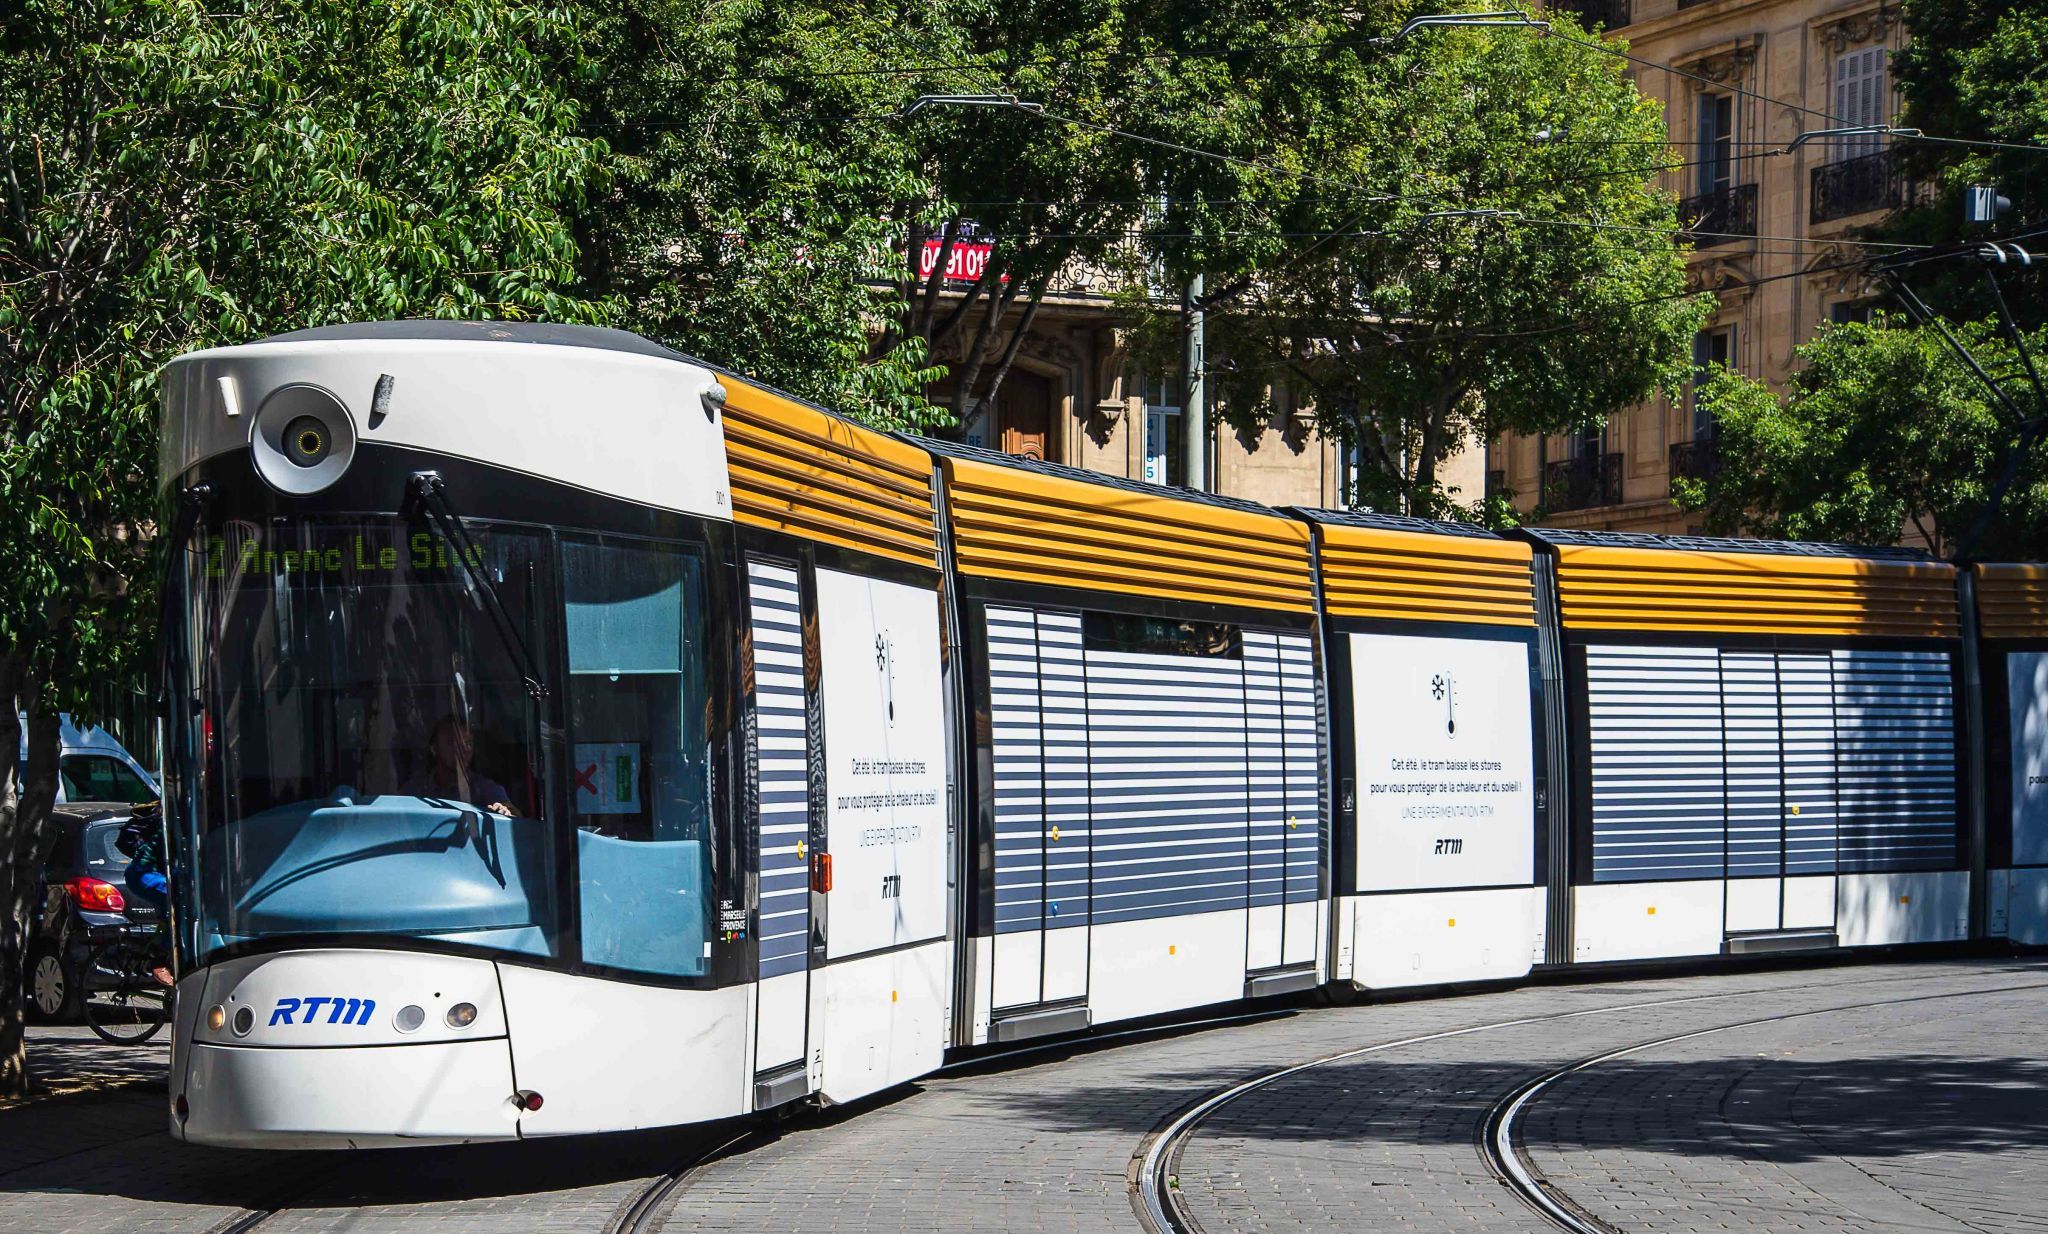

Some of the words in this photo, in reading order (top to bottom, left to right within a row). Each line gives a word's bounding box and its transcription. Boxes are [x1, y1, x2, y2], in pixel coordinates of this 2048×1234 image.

[203, 535, 225, 577] 2
[240, 538, 341, 574] Arenc
[355, 535, 397, 570] Le
[1392, 758, 1405, 770] Cet
[1420, 758, 1427, 770] le
[1428, 758, 1445, 770] tram
[1446, 758, 1468, 770] baisse
[1469, 758, 1479, 770] les
[1480, 758, 1502, 771] stores
[1370, 783, 1388, 796] pour
[1389, 783, 1405, 792] vous
[1407, 780, 1438, 796] protéger
[1439, 780, 1447, 792] de
[1449, 780, 1455, 792] la
[1456, 780, 1481, 792] chaleur
[1483, 781, 1490, 792] et
[1491, 780, 1500, 792] du
[1434, 838, 1462, 855] RTM
[882, 875, 901, 899] RTM
[268, 997, 376, 1027] RTM
